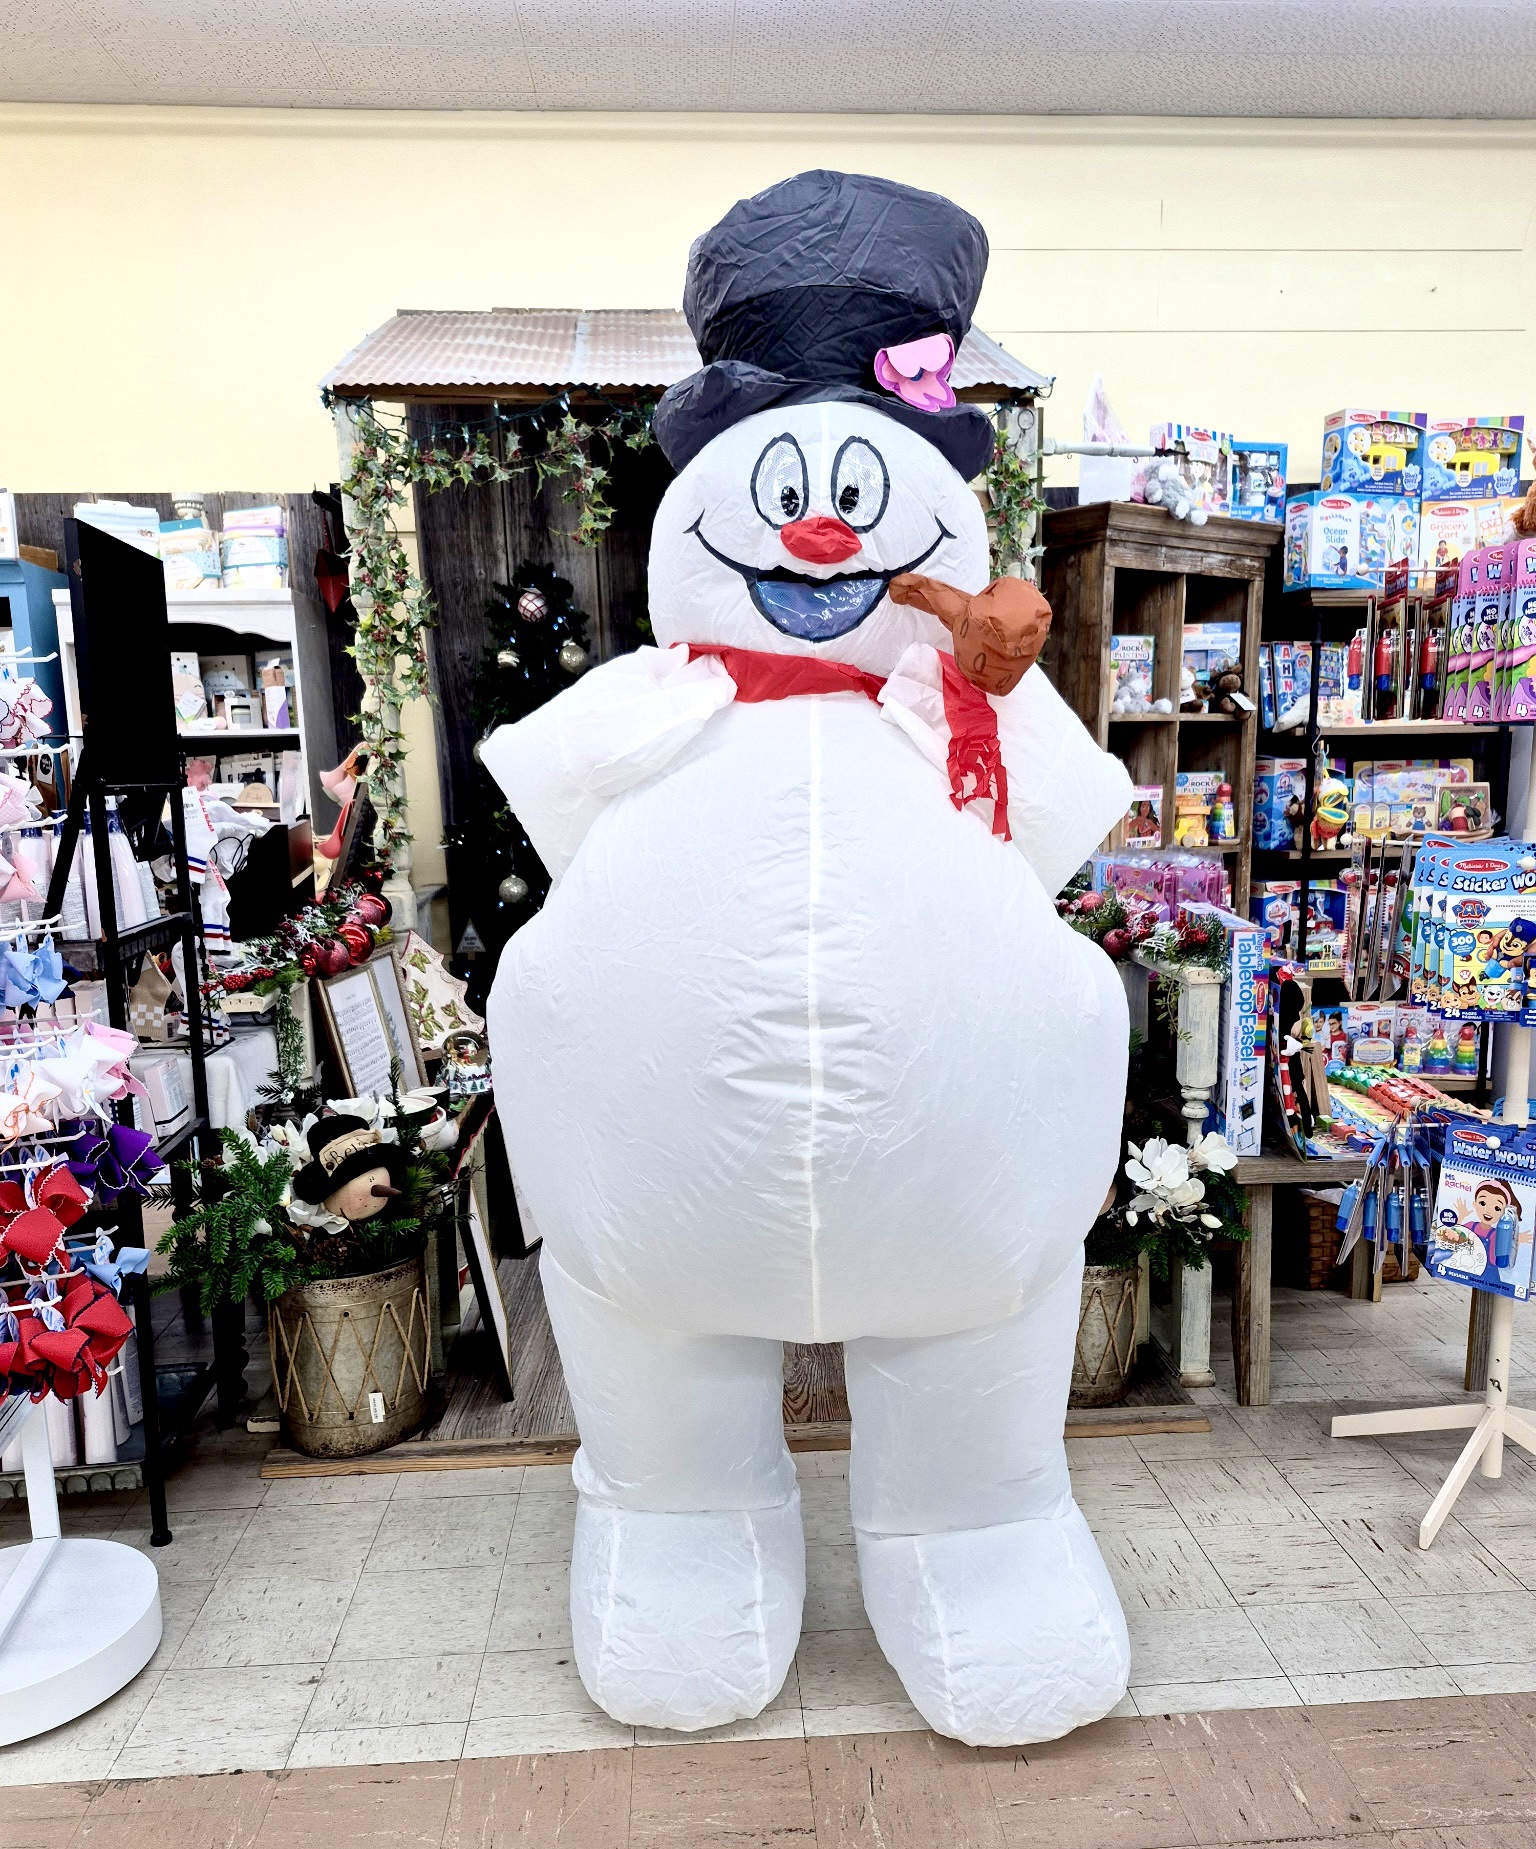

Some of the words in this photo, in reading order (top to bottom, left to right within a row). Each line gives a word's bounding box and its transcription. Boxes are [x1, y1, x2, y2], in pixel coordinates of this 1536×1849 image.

[1323, 526, 1348, 535] Ocean
[1438, 531, 1459, 539] Cart
[1325, 535, 1346, 544] Slide
[1473, 705, 1484, 719] 4
[1516, 703, 1528, 717] 4
[1452, 875, 1508, 893] Sticker
[1451, 902, 1492, 918] PAW
[1451, 935, 1474, 947] 300
[1255, 933, 1265, 970] Magnetic
[1393, 962, 1404, 974] 24
[1444, 1008, 1460, 1018] 24
[1453, 1140, 1492, 1160] Water
[1494, 1149, 1536, 1170] WOW!
[1444, 1179, 1472, 1192] Rachel
[1437, 1263, 1447, 1276] 4
